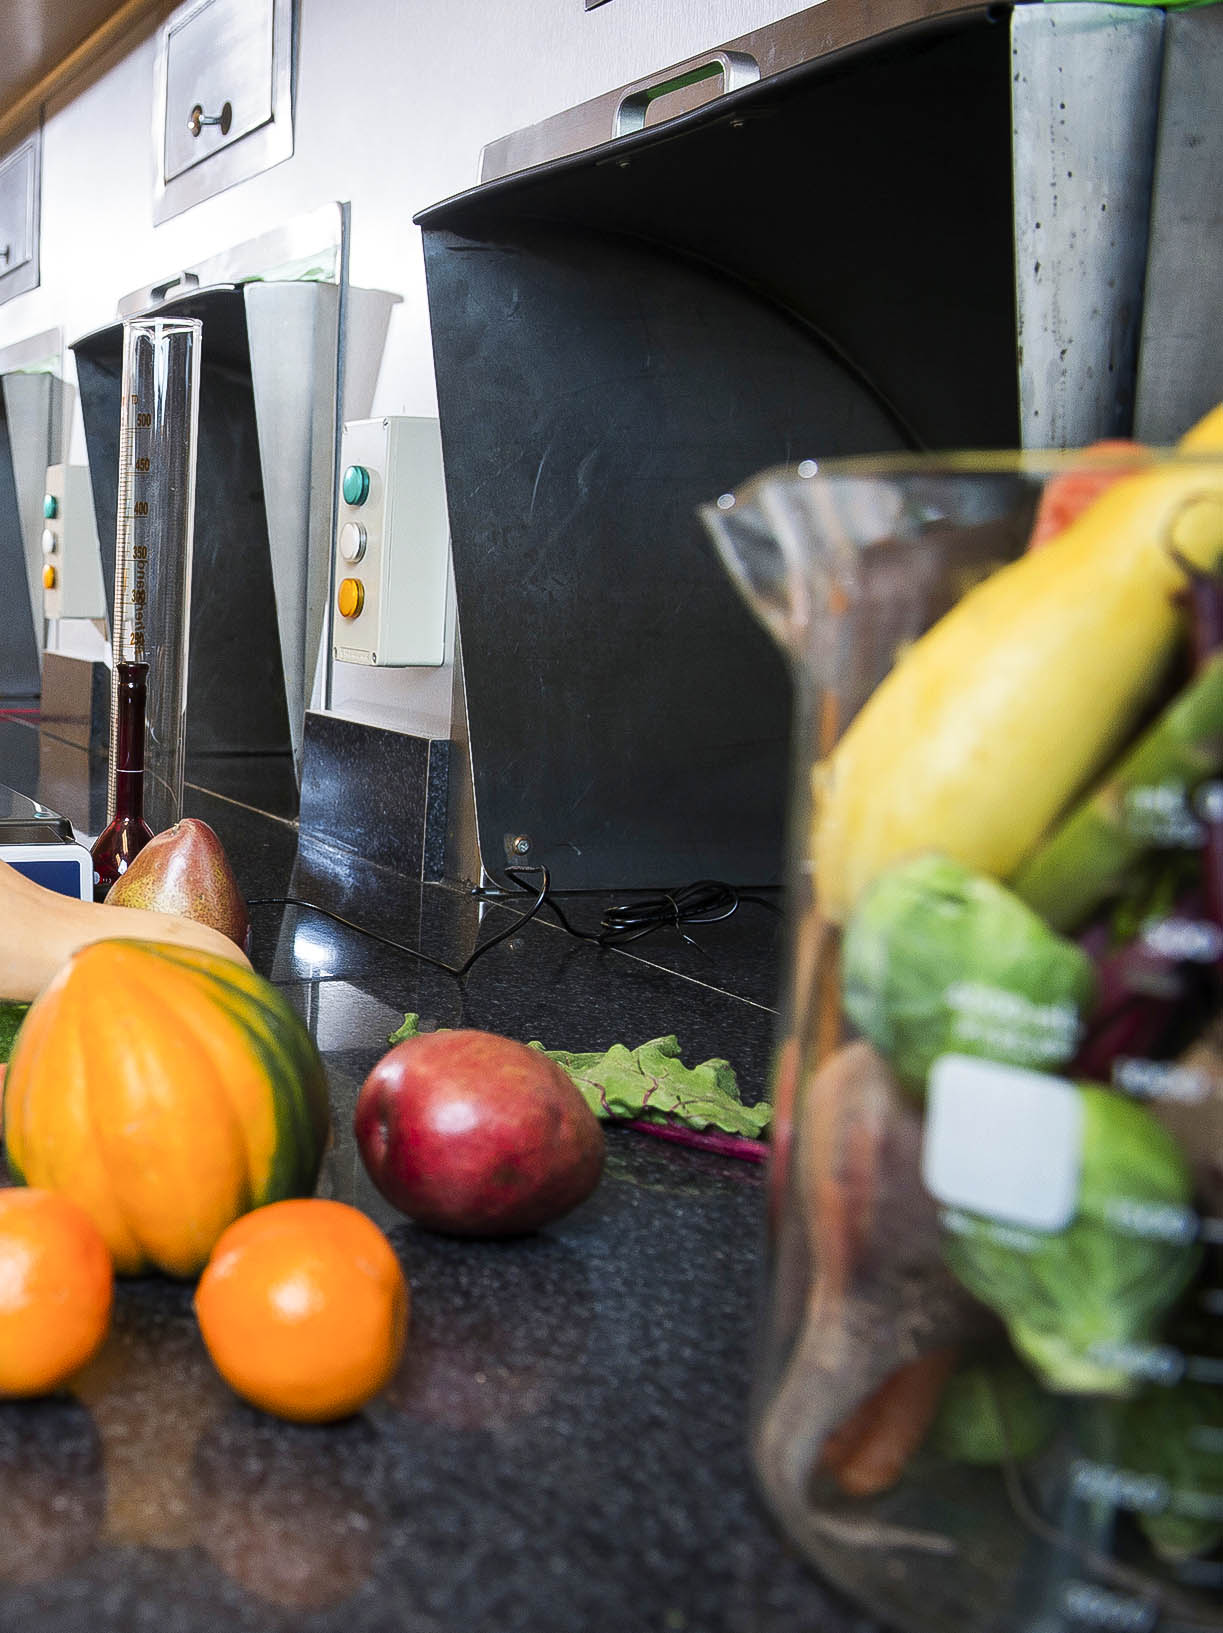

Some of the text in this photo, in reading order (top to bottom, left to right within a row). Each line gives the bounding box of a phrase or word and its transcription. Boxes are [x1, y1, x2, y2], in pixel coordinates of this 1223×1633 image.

[137, 413, 152, 427] 500
[136, 458, 150, 471] 450
[134, 501, 148, 515] 400
[133, 546, 147, 559] 350
